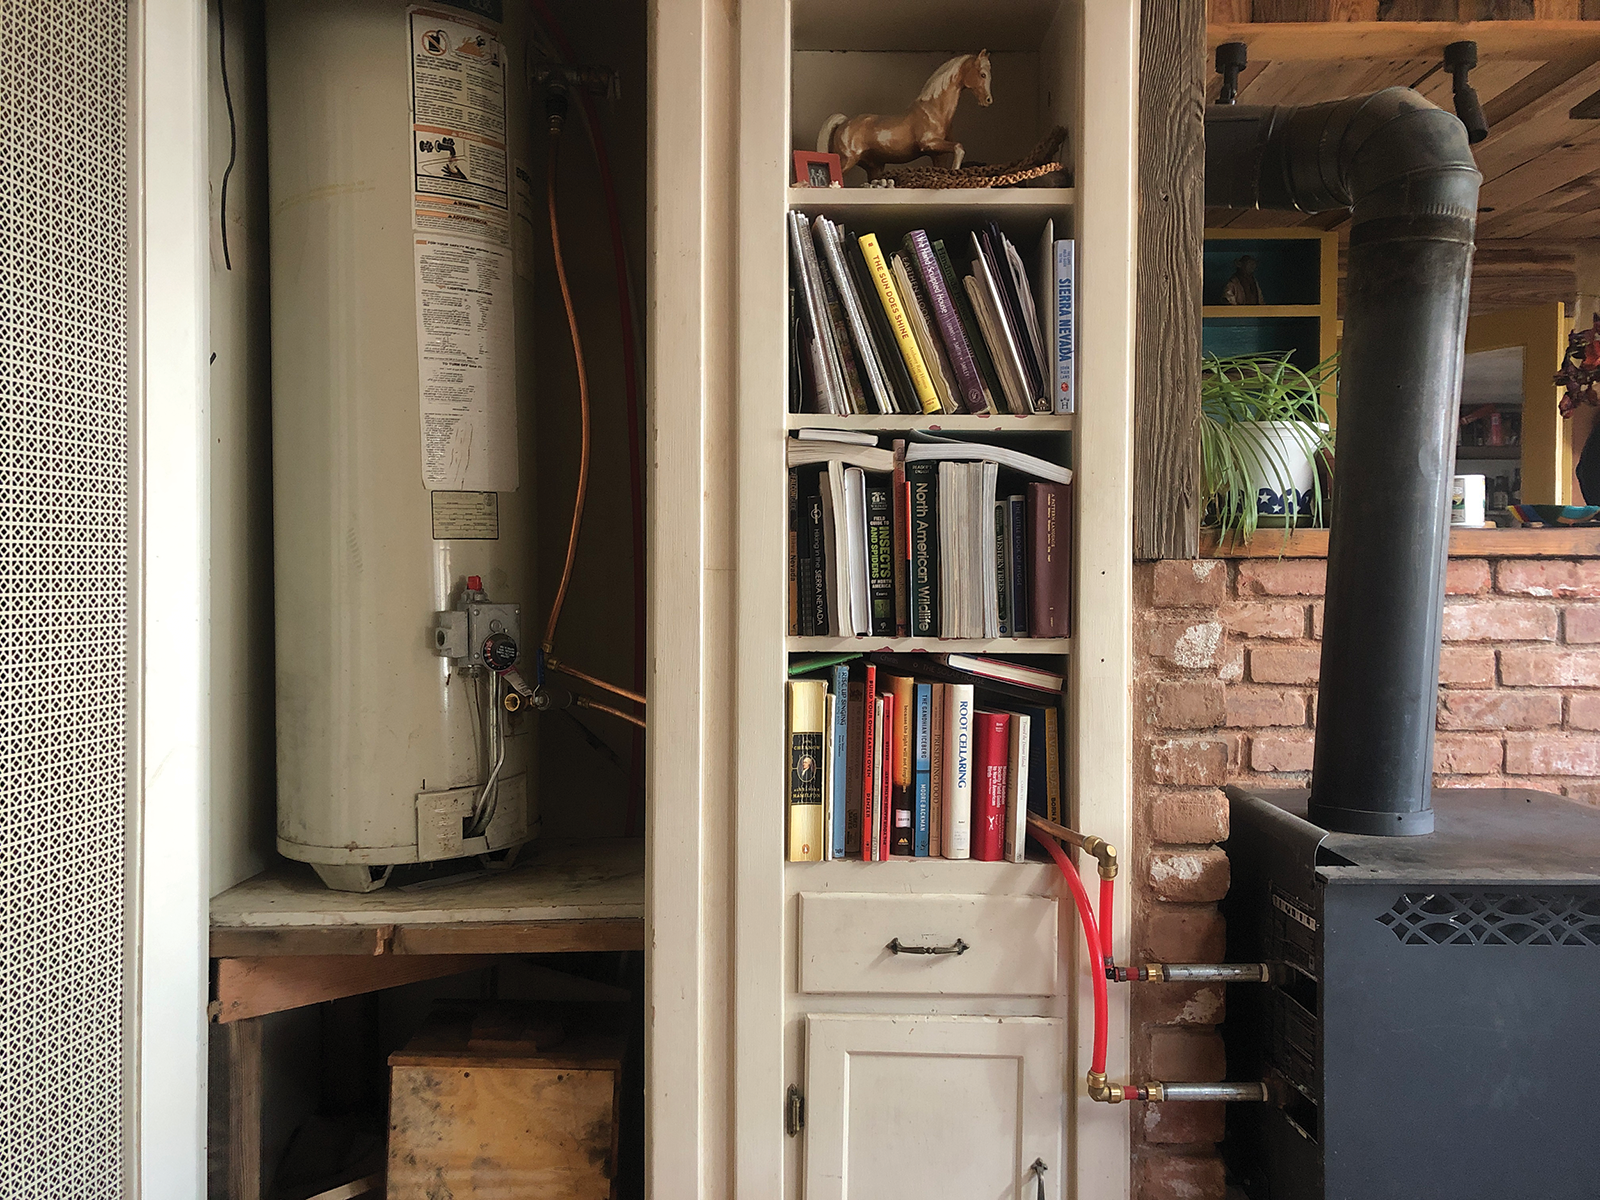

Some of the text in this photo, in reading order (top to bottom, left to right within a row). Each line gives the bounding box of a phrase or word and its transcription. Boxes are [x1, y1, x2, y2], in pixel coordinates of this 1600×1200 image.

[902, 256, 930, 324] EARTHEN FLOORS
[938, 247, 957, 290] Handmade
[872, 255, 908, 339] THE SUN DOES SHINE
[936, 293, 948, 313] House
[1058, 277, 1071, 361] SIERRA NEVADA
[812, 528, 820, 548] Hiking
[871, 545, 879, 578] SPIDERS
[879, 527, 891, 578] INSECTS
[916, 482, 930, 631] North American Wildlife
[840, 688, 846, 697] UP
[922, 663, 985, 684] THE SOLAR HOUSE
[956, 700, 968, 788] ROOT CELLARING
